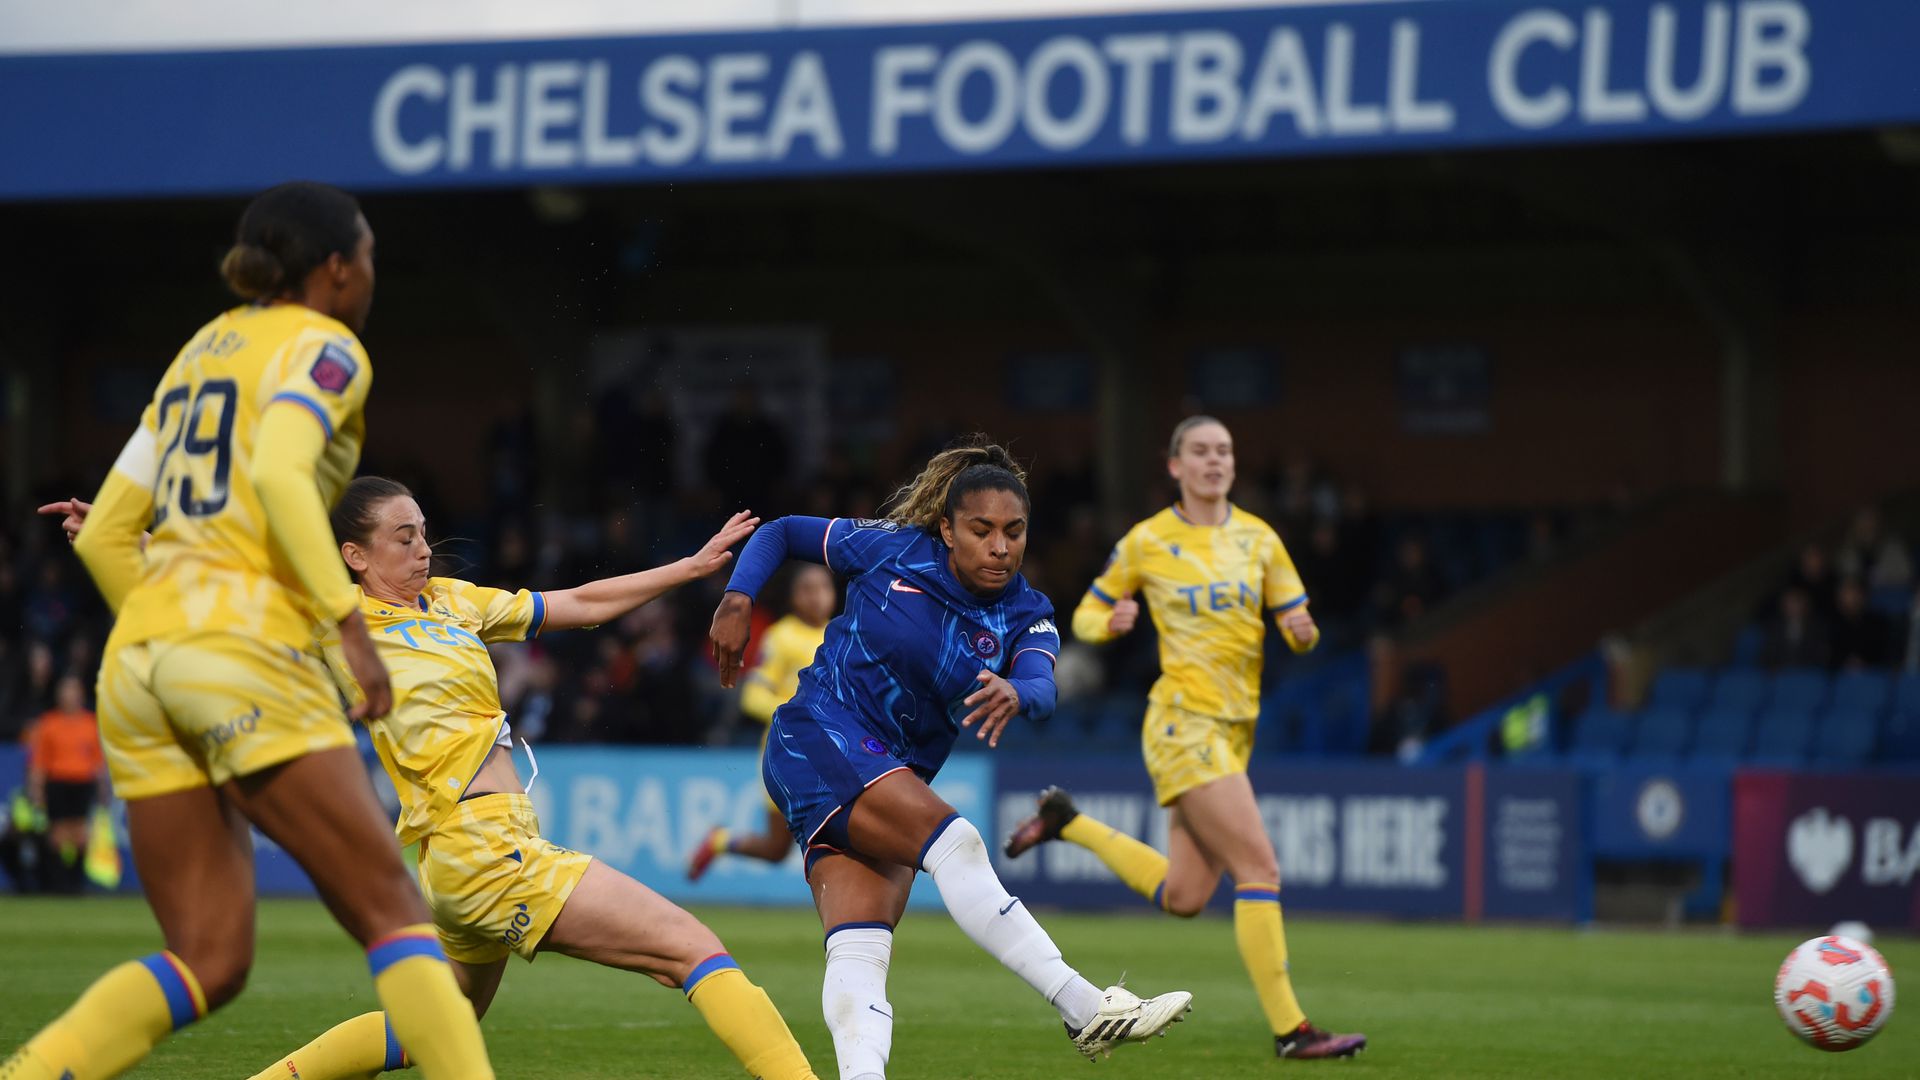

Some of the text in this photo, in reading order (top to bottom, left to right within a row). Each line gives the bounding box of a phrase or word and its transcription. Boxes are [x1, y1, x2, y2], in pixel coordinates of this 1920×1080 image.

[372, 1, 1811, 175] CHELSEA FOOTBALL CLUB
[153, 377, 238, 524] 29
[1176, 581, 1259, 617] TEN
[1343, 796, 1448, 887] HERE
